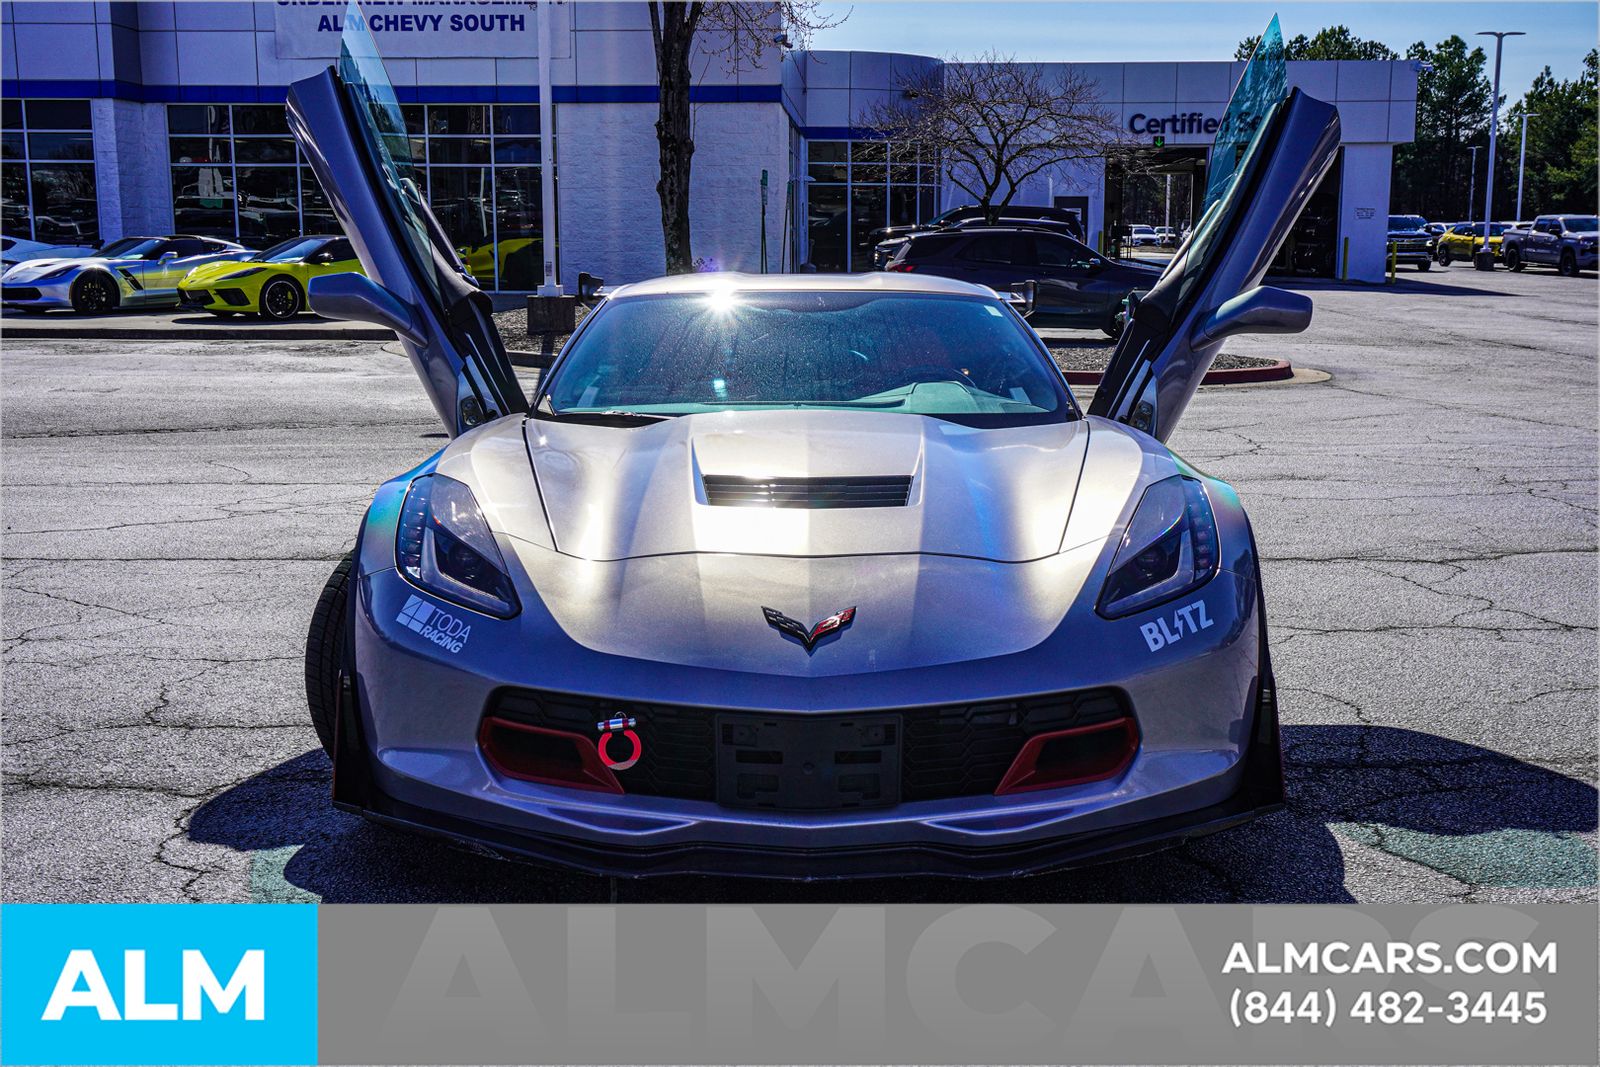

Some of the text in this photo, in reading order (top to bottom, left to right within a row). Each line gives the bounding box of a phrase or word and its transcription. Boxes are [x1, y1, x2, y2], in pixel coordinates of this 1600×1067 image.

[318, 14, 525, 32] ALM CHEVY SOUTH
[1129, 112, 1231, 135] Certified
[430, 608, 471, 643] TODA
[420, 625, 463, 653] RACING
